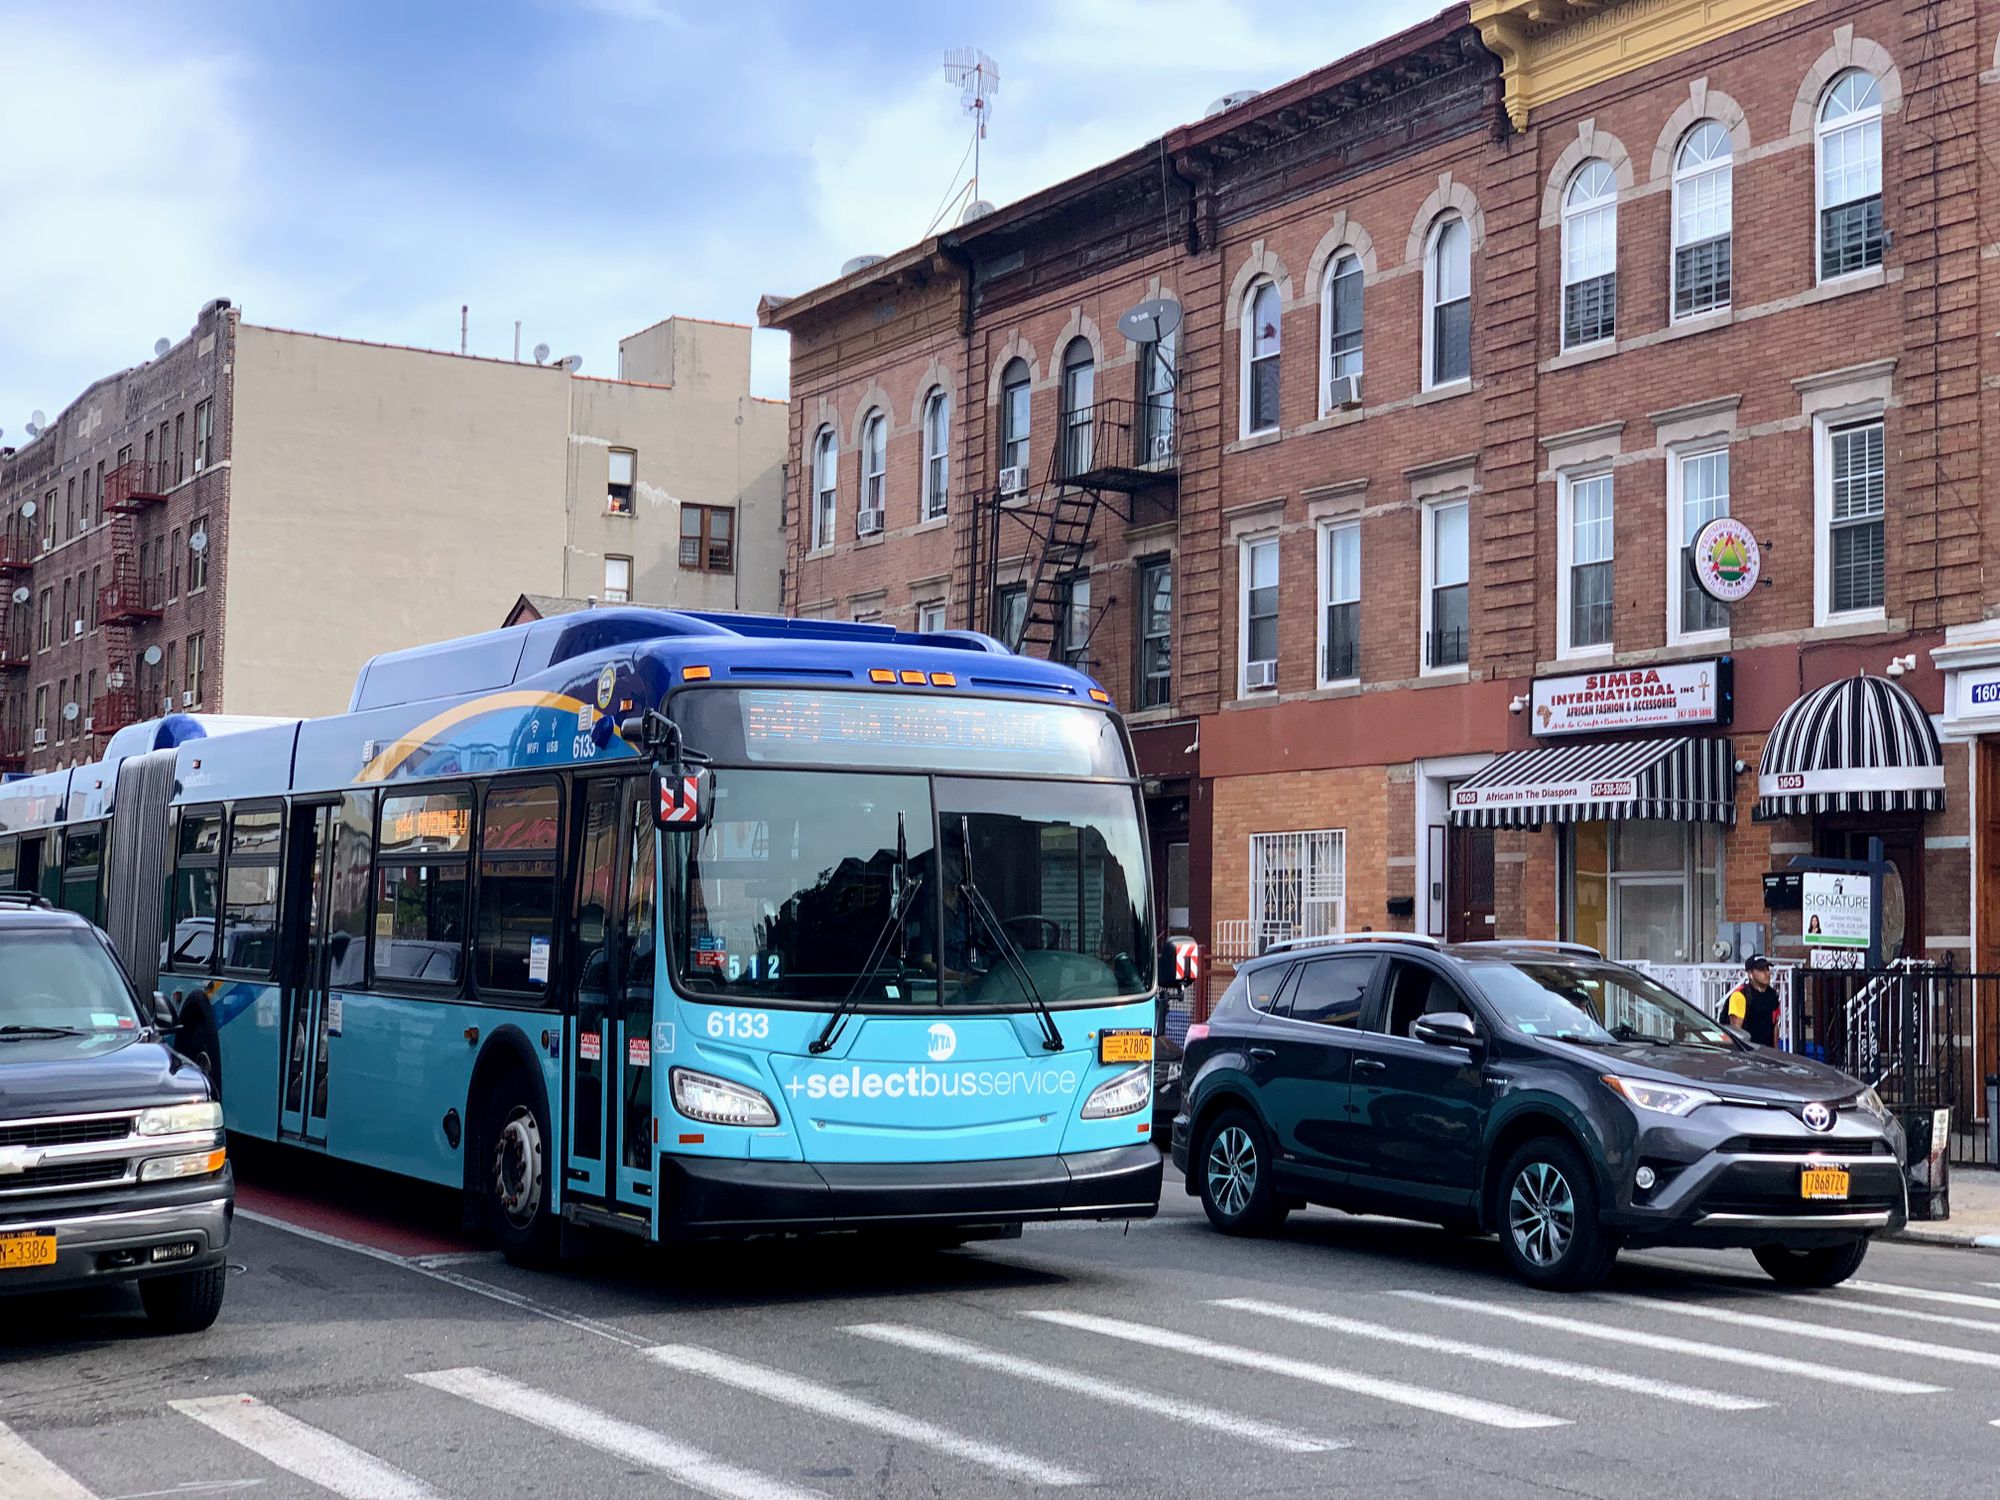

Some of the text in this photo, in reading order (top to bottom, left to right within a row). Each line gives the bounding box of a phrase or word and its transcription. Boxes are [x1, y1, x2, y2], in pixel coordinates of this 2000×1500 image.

[1585, 670, 1660, 690] SIMBA
[1551, 684, 1694, 706] INTERNATIONAL INC
[1566, 697, 1677, 718] AFRICAN FASHION & ACCESSORIES
[1577, 719, 1599, 728] Craft
[527, 741, 558, 754] WIFI USB
[573, 735, 595, 759] 6133
[1780, 775, 1802, 789] 1605
[1458, 792, 1476, 804] 1605
[1486, 792, 1513, 802] African
[1516, 791, 1523, 800] In
[1525, 789, 1540, 799] The
[1542, 788, 1578, 799] Diaspora
[1804, 893, 1869, 909] SIGNATURE
[729, 954, 740, 979] 5
[749, 954, 757, 979] 1
[768, 954, 779, 979] 2
[707, 1011, 769, 1039] 6133
[581, 1033, 600, 1045] CAUTION
[629, 1039, 650, 1050] CAUTION
[1129, 1037, 1150, 1055] 7805
[1804, 1173, 1847, 1191] T786872C
